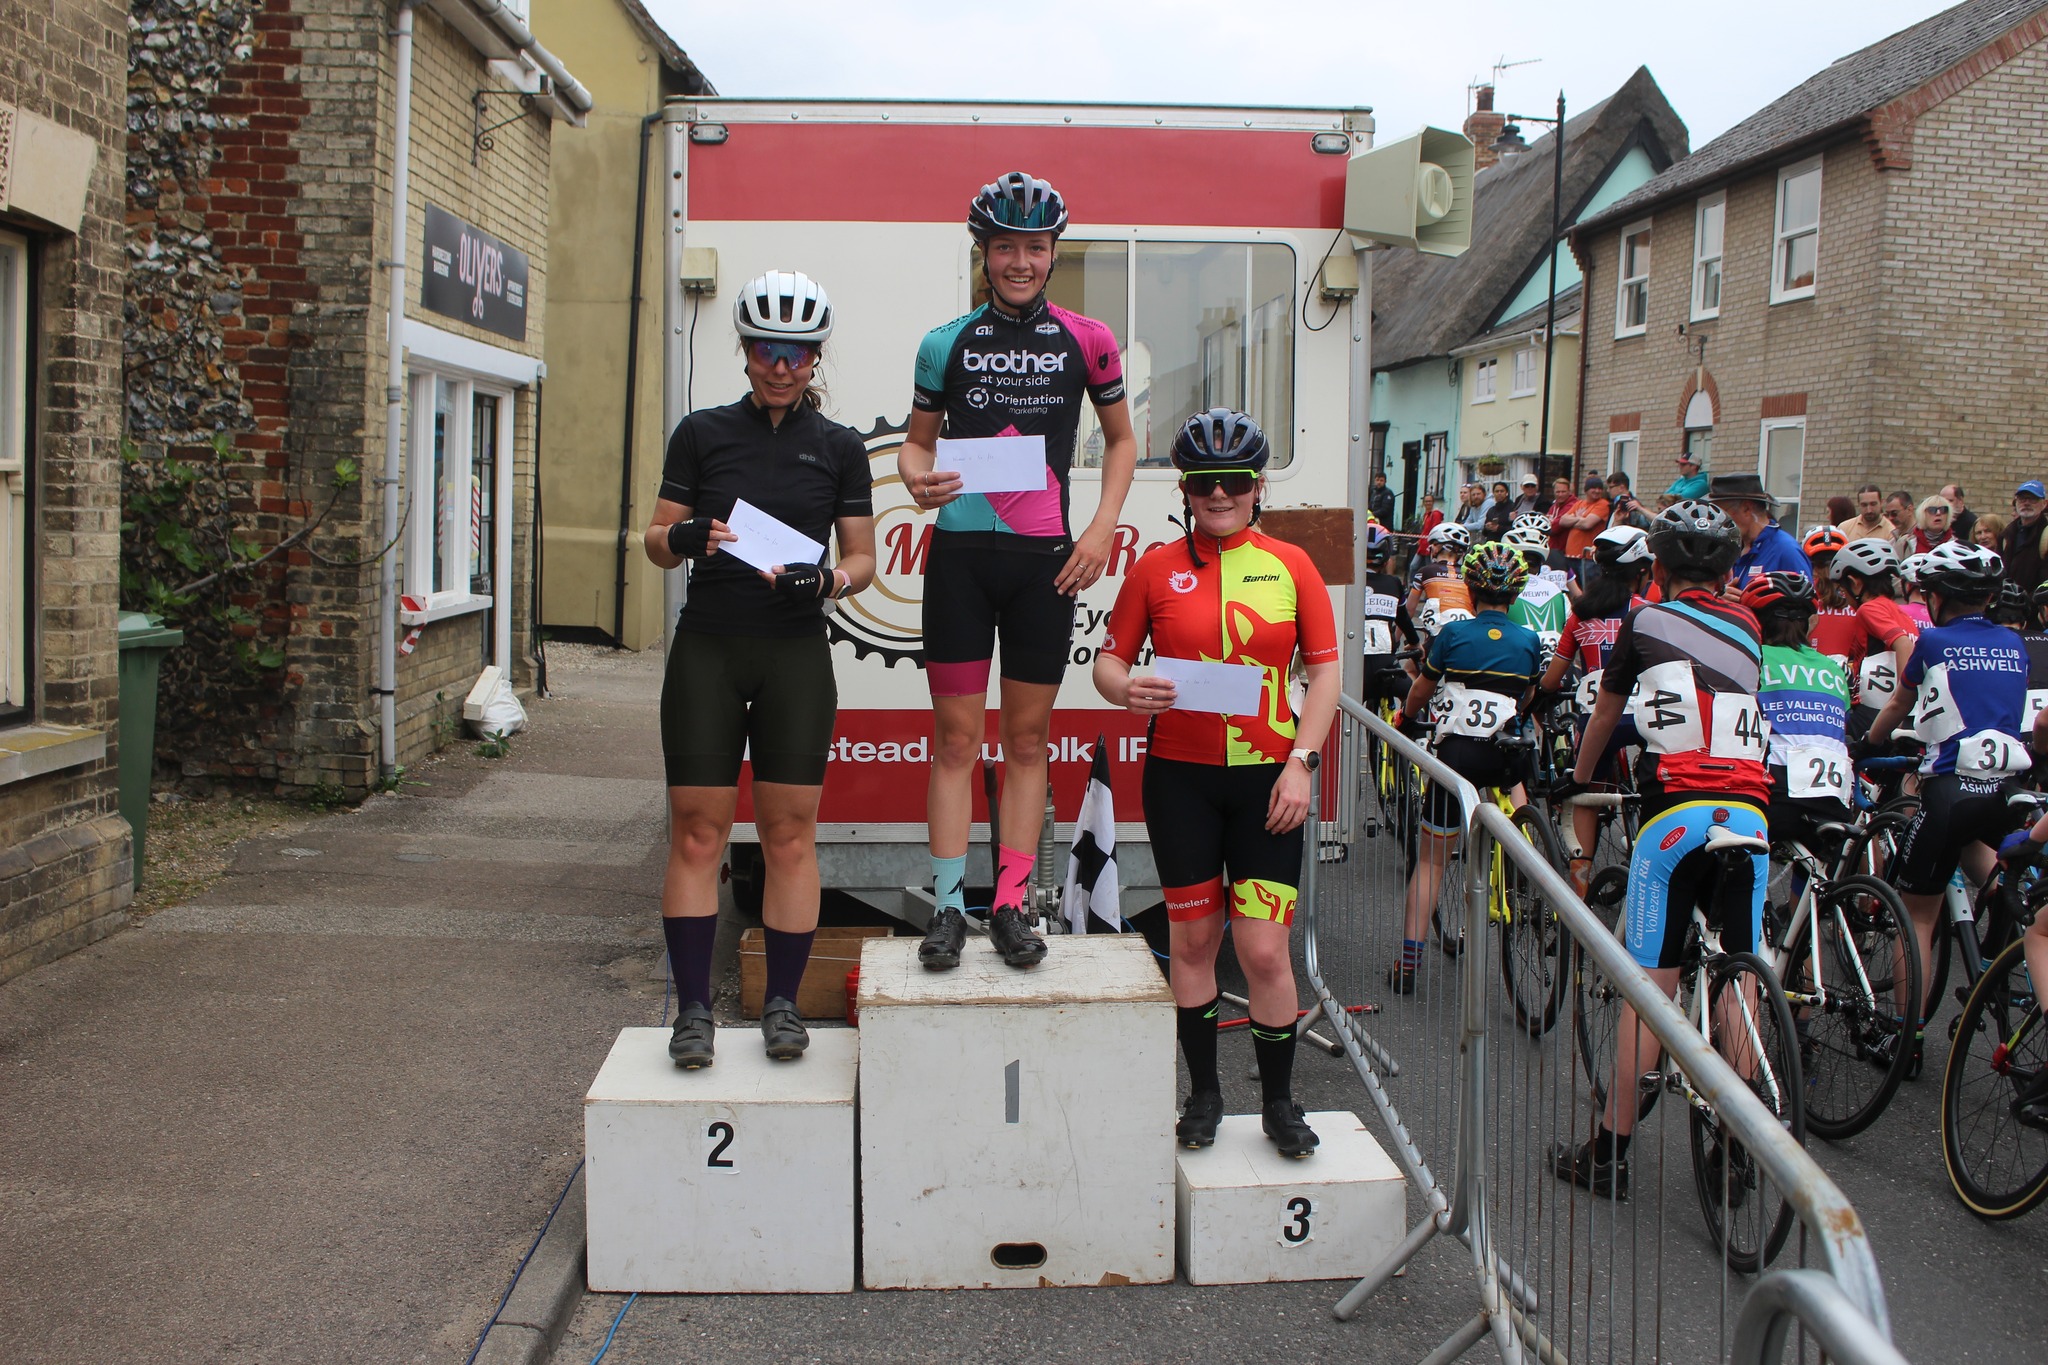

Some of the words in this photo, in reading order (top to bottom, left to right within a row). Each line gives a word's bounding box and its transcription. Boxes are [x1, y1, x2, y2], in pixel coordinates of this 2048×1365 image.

[963, 349, 1068, 374] brother
[980, 375, 993, 384] at
[996, 376, 1024, 388] your
[1025, 374, 1051, 387] side
[994, 392, 1064, 406] Orientation
[1009, 405, 1048, 415] marketing
[799, 453, 816, 462] dhb
[1242, 573, 1281, 583] Santini
[1522, 590, 1550, 598] WELWYN
[1943, 646, 1988, 658] CYCLE
[1990, 648, 2020, 660] CLUB
[1945, 658, 2023, 673] ASHWELL
[1763, 664, 1846, 696] LVYCC
[1868, 665, 1895, 694] 42
[1466, 699, 1499, 728] 35
[1644, 689, 1686, 731] 44
[1762, 701, 1784, 711] LEE
[1786, 700, 1827, 711] VALLEY
[1734, 707, 1764, 748] 44
[1776, 713, 1824, 723] CYCLING
[1826, 715, 1845, 730] CLUB
[1978, 738, 2010, 771] 31
[1808, 757, 1843, 789] 26
[1902, 811, 1927, 864] ASHWELL
[1639, 857, 1652, 880] Rik
[1645, 880, 1661, 934] Vollezele
[1005, 1059, 1019, 1123] 1
[708, 1121, 734, 1168] 2
[1284, 1197, 1312, 1243] 3
